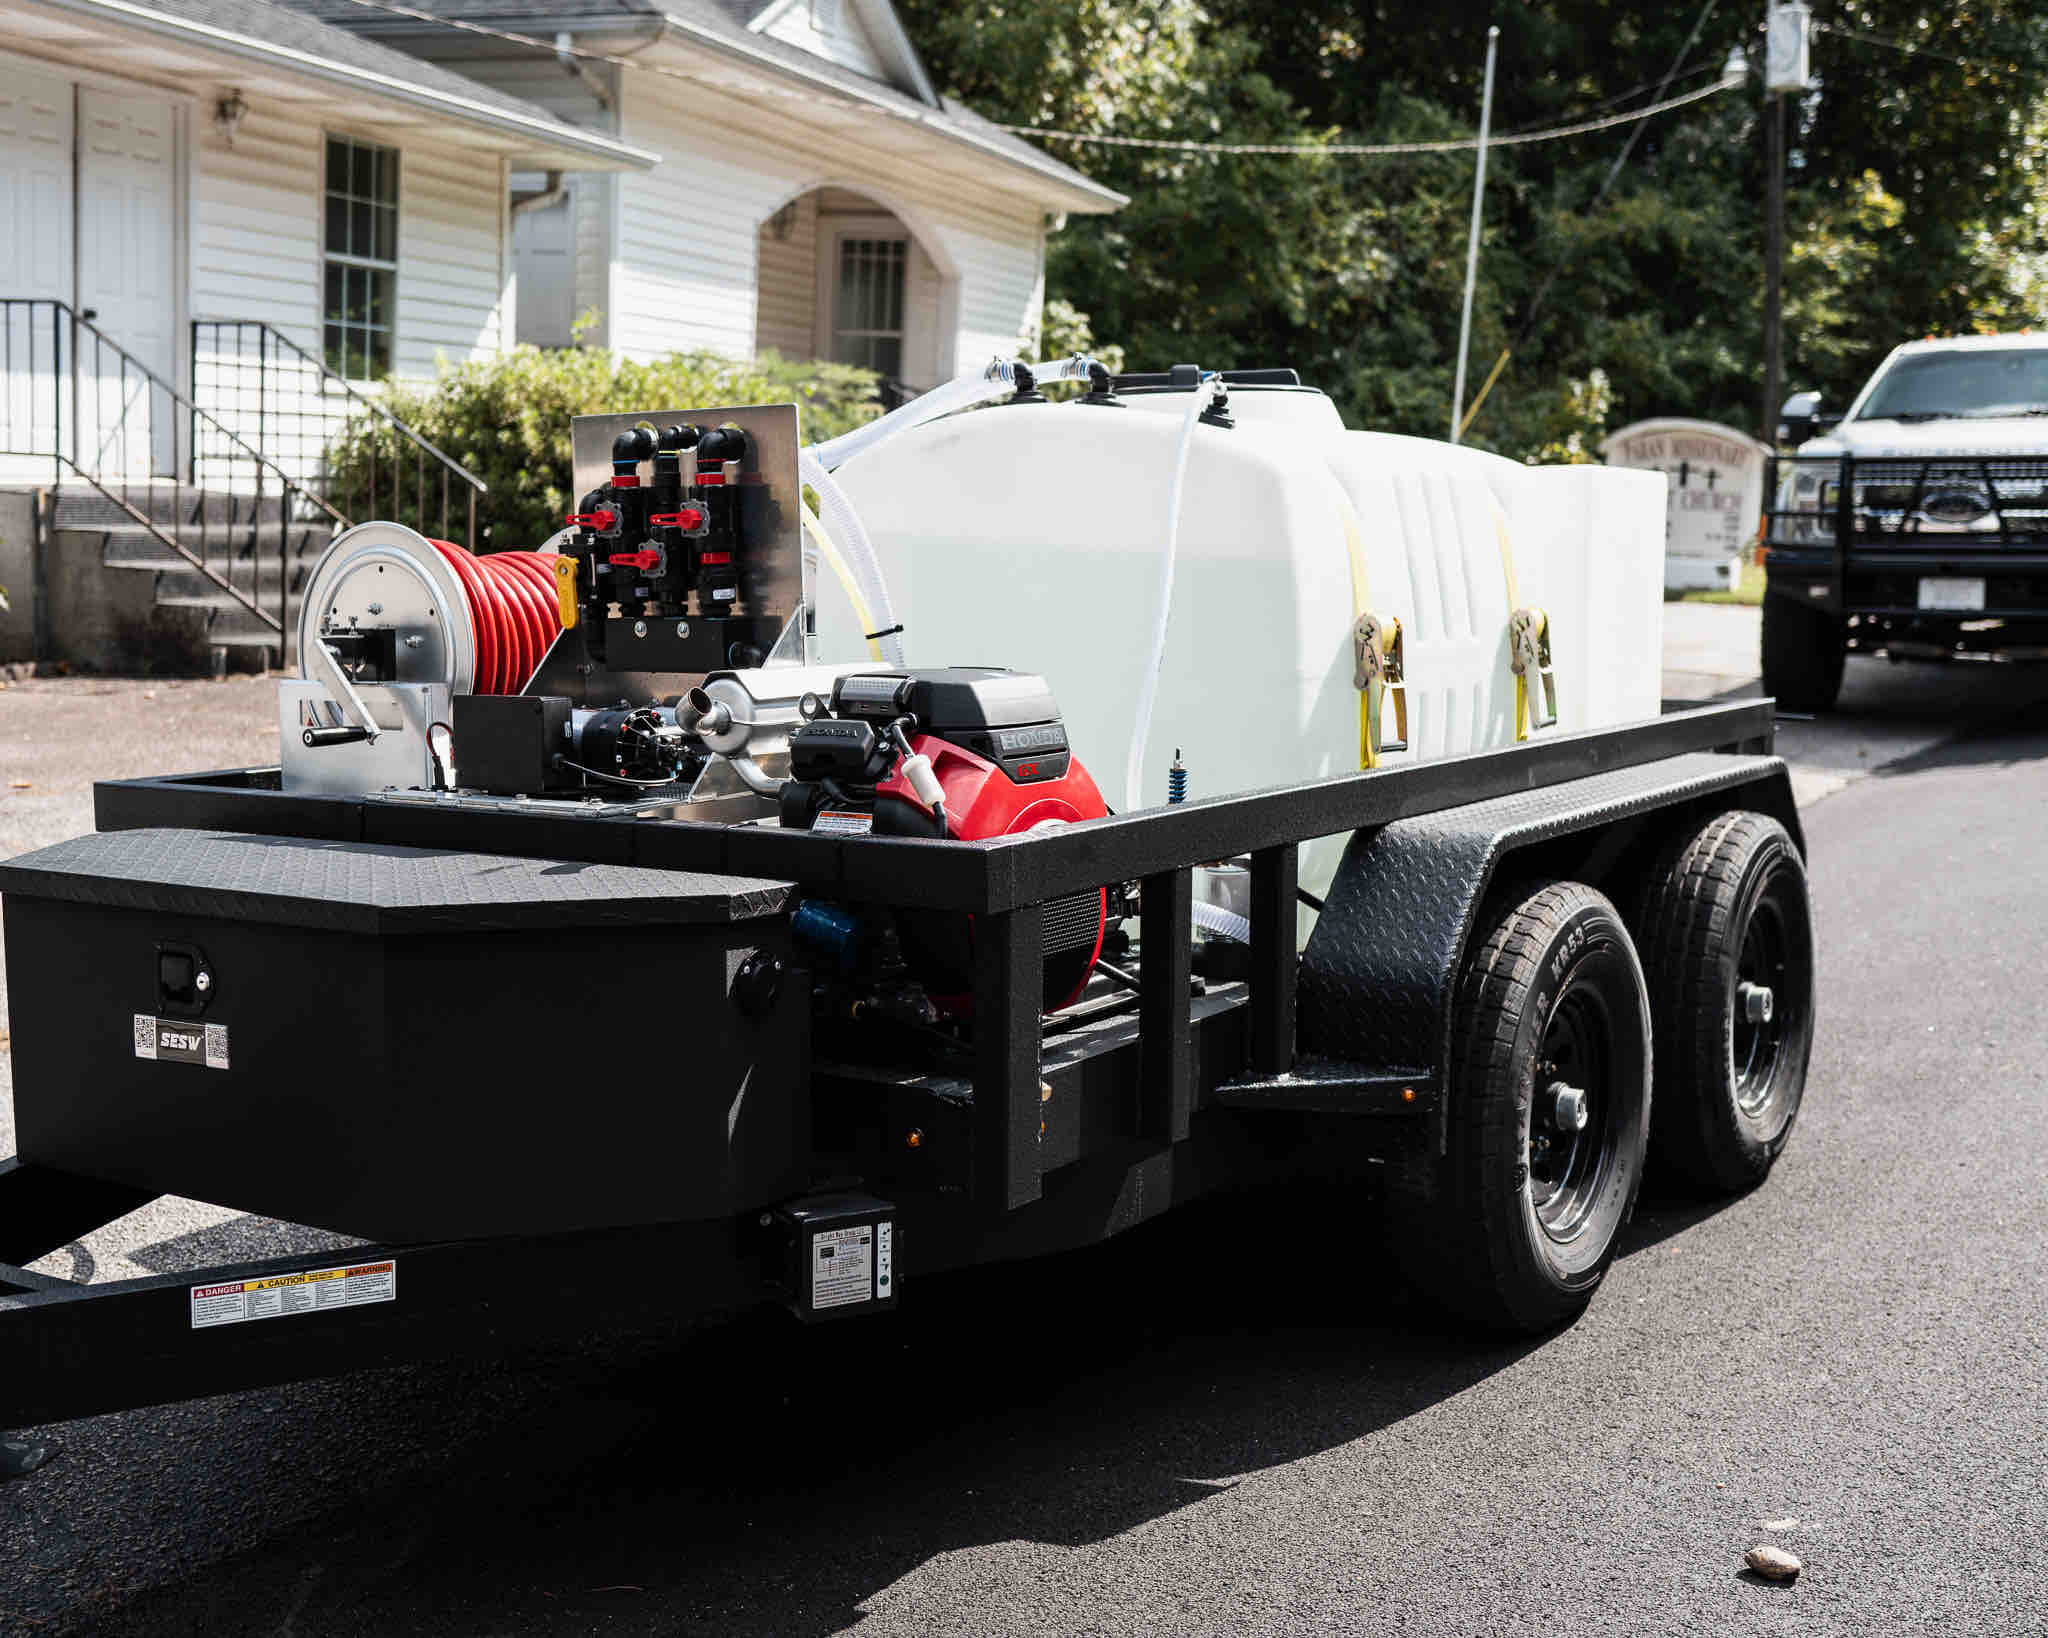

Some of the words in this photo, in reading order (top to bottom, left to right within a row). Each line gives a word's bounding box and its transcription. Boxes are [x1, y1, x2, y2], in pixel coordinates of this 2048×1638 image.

[1001, 729, 1065, 750] HONDA
[1018, 763, 1039, 776] GX
[160, 1032, 201, 1051] SESW
[268, 1276, 305, 1288] CAUTION
[205, 1284, 241, 1296] DANGER
